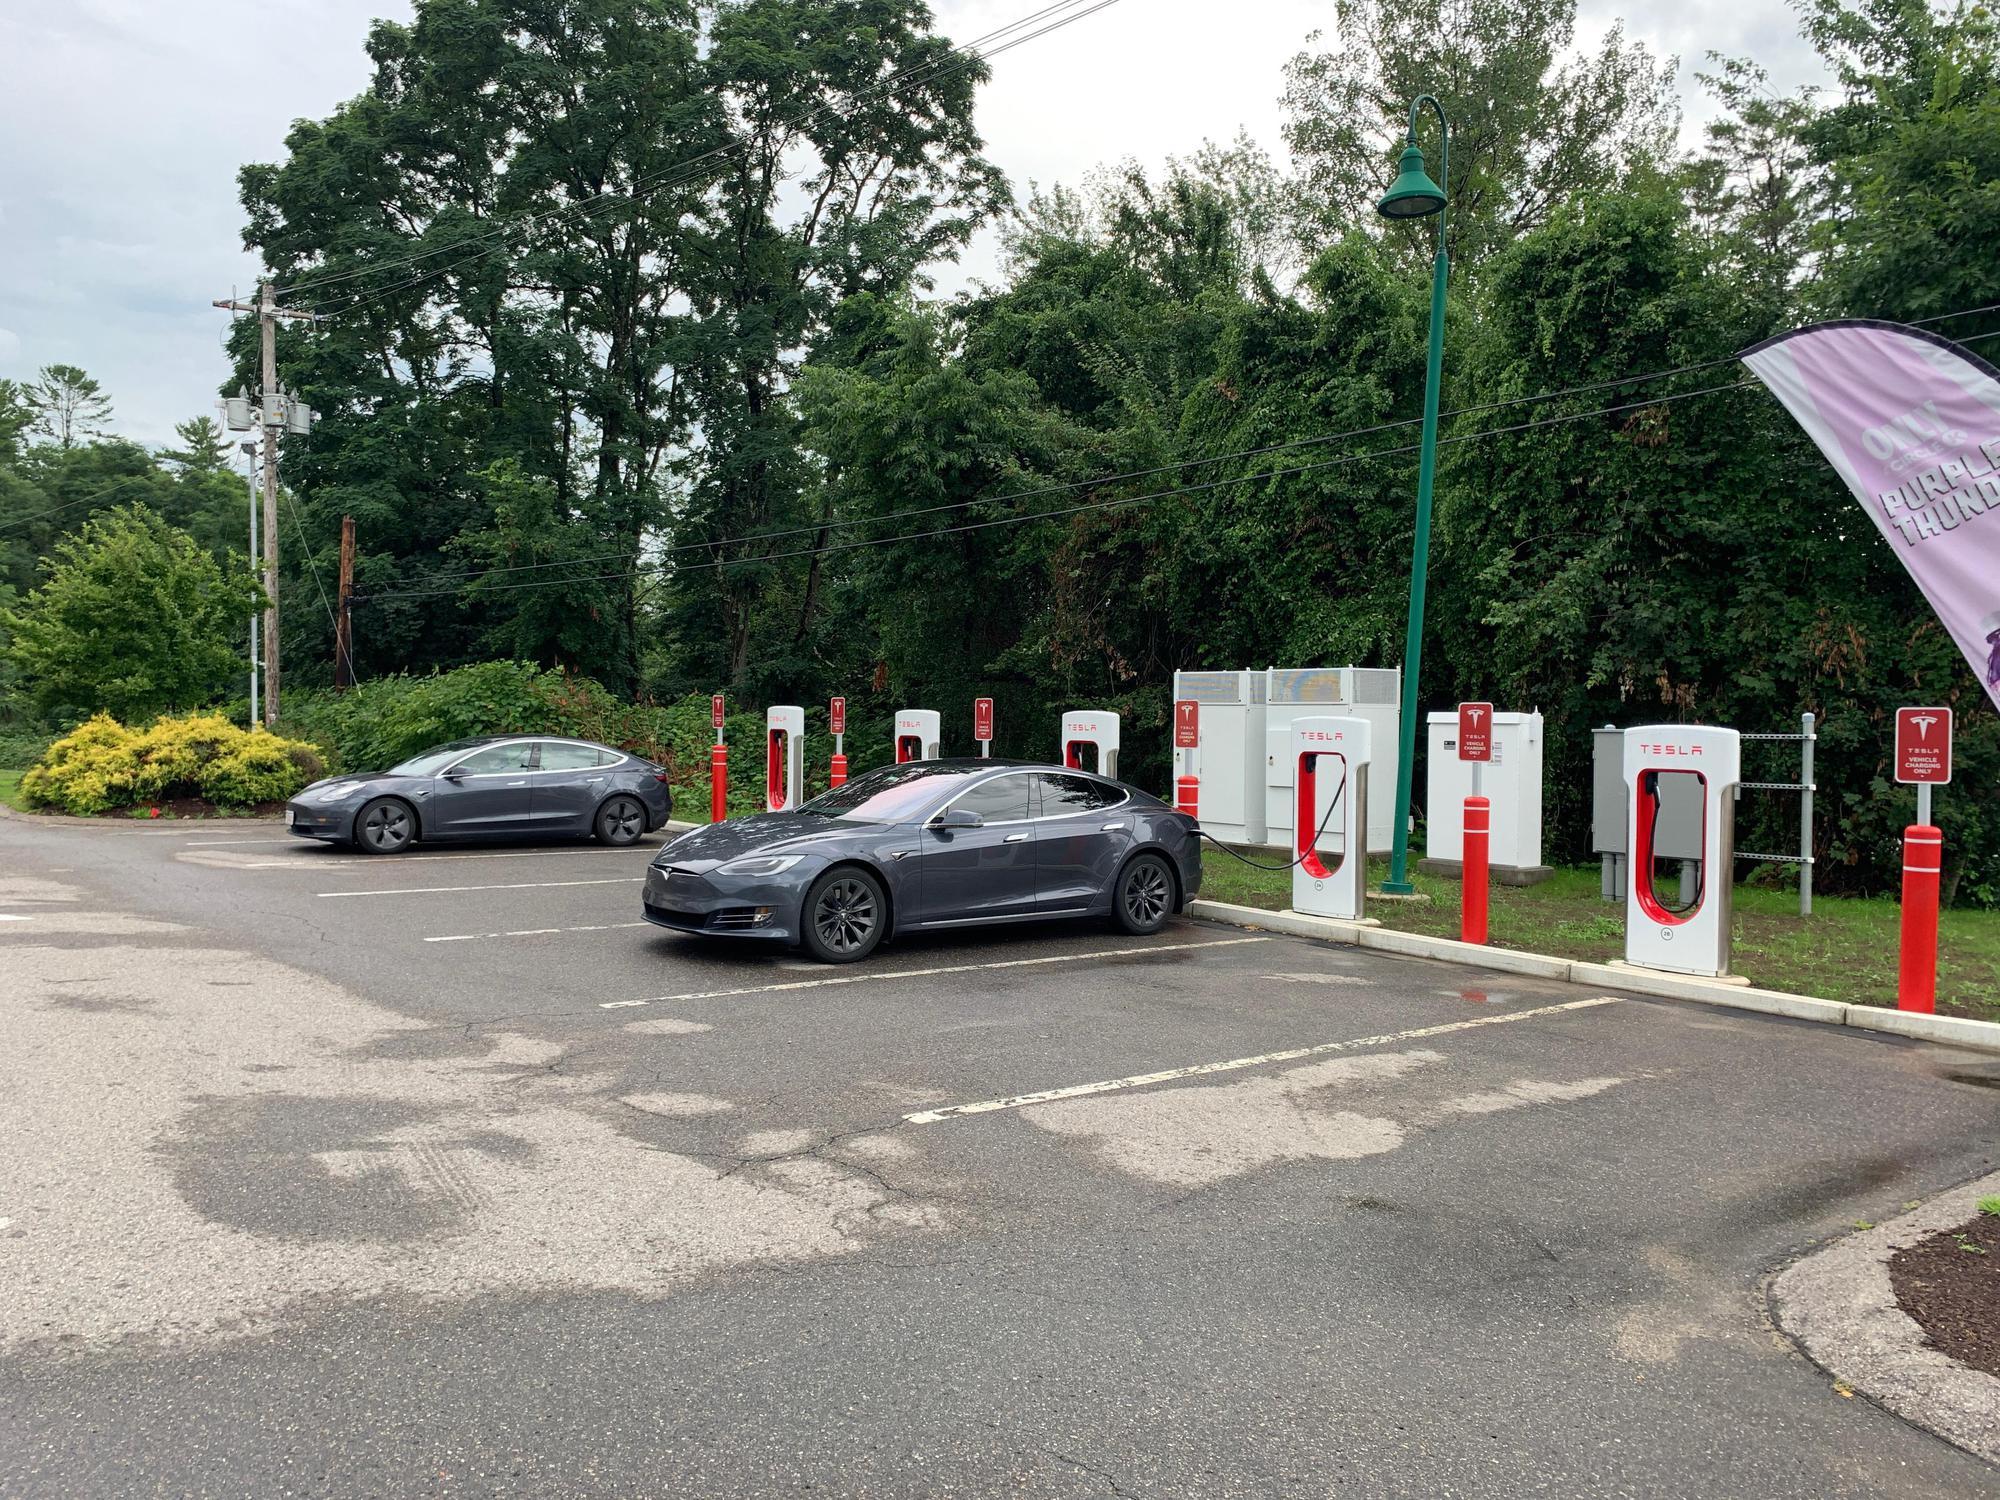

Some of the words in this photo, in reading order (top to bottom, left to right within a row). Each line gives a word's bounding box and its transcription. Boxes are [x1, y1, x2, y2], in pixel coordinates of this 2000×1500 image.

[1862, 400, 1949, 460] ONLY
[1892, 474, 2000, 547] THUND
[898, 720, 920, 728] TESLA
[1067, 723, 1097, 732] TESLA
[1300, 731, 1343, 741] TESLA
[1640, 744, 1703, 756] TESLA
